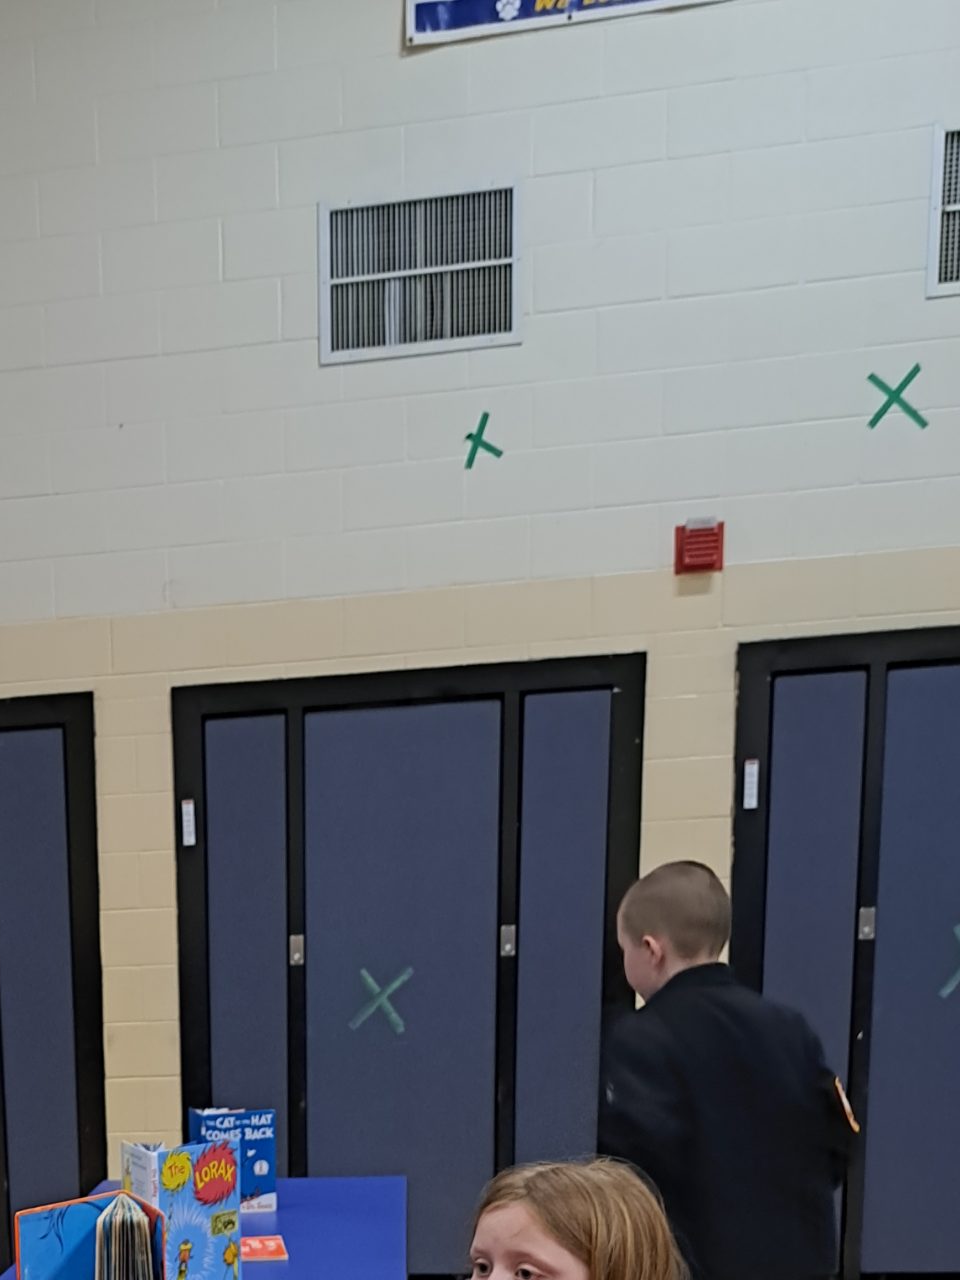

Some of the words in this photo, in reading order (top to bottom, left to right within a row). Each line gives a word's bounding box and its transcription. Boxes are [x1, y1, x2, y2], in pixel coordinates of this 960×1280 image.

[215, 1116, 236, 1129] CAT
[250, 1113, 273, 1126] HAT
[244, 1127, 274, 1140] BACK
[194, 1158, 236, 1190] LORAX
